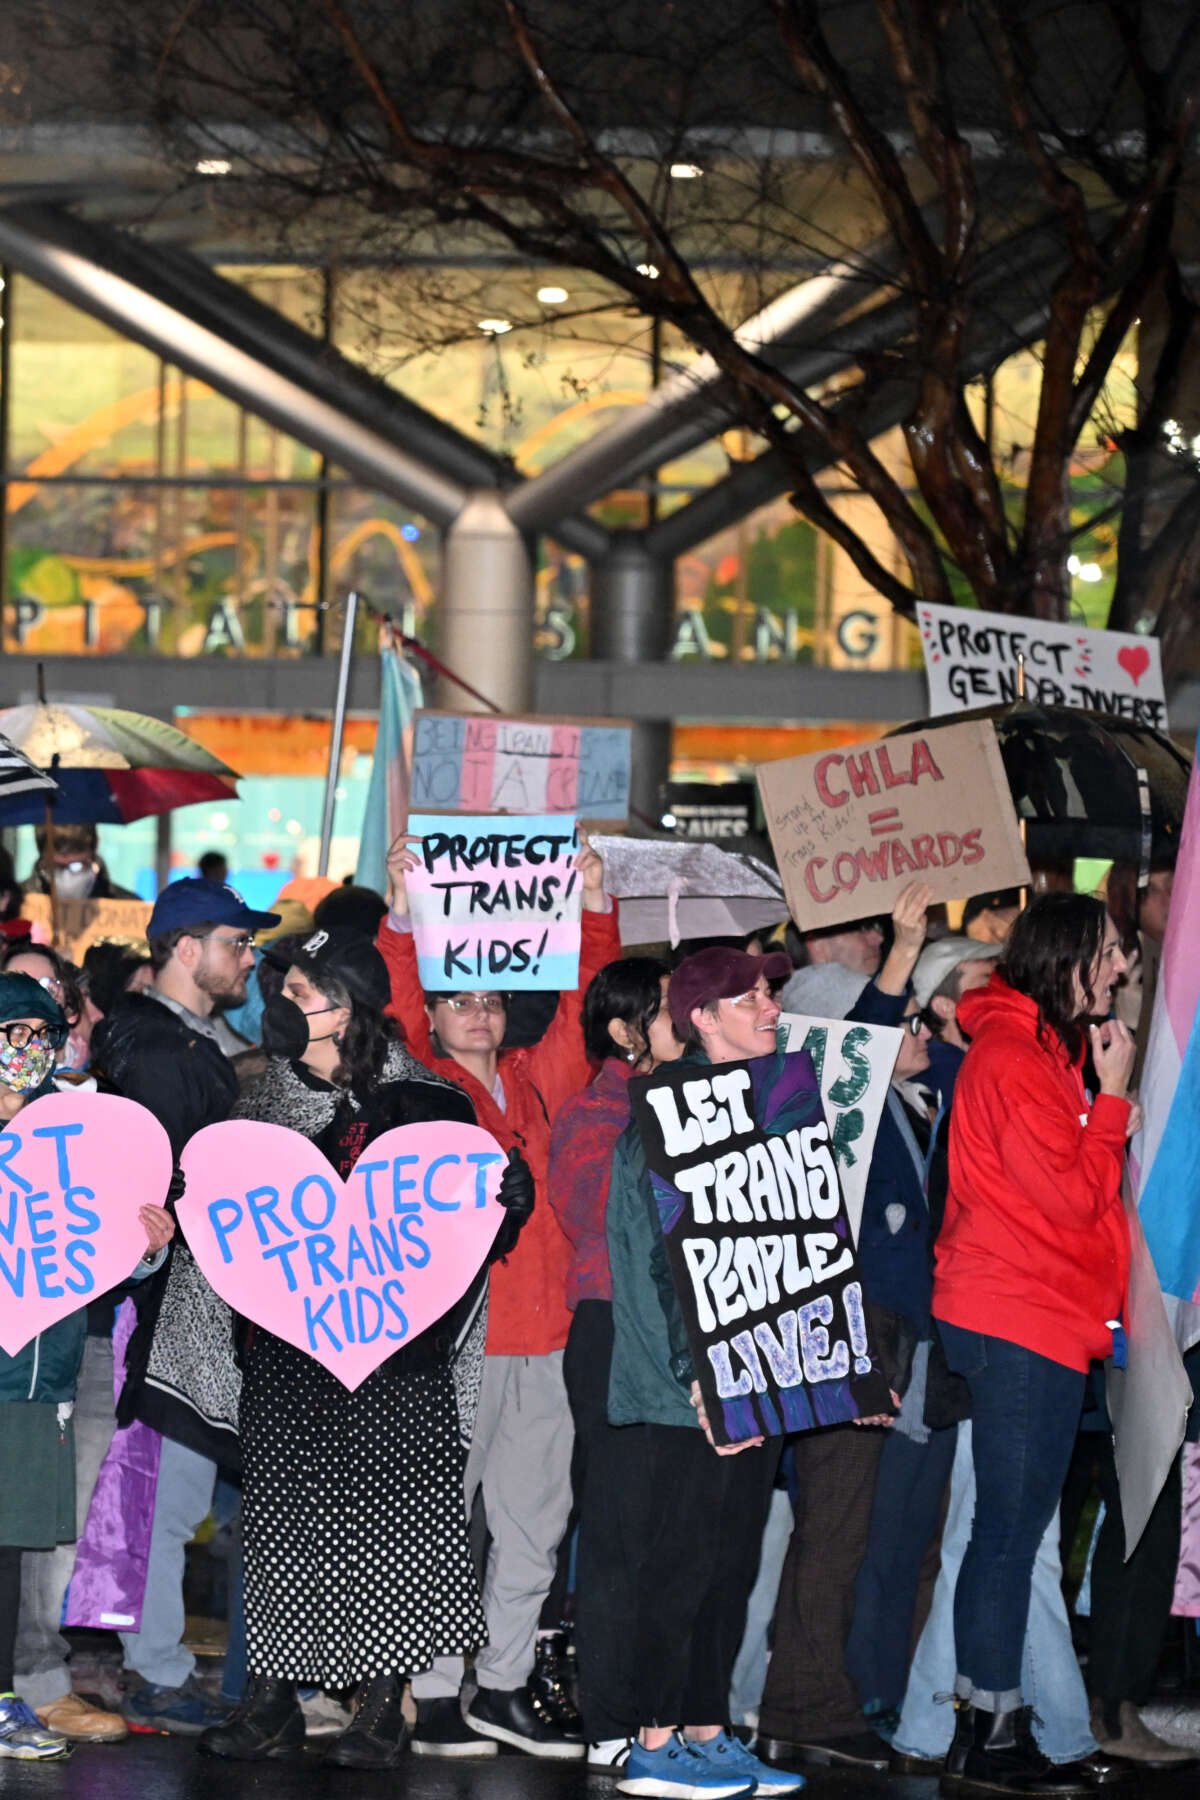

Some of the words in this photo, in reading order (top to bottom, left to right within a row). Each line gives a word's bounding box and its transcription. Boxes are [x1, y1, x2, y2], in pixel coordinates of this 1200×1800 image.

[938, 619, 1072, 674] PROTECT
[814, 738, 945, 808] CHLA
[422, 827, 579, 875] PROTECT!
[804, 828, 986, 904] COWARDS
[430, 869, 578, 922] TRANS!
[443, 927, 550, 980] KIDS!
[645, 1068, 755, 1158] LET
[207, 1152, 504, 1265] PROTECT
[673, 1121, 841, 1224] TRANS
[262, 1213, 432, 1293] TRANS
[681, 1232, 855, 1334] PEOPLE
[303, 1278, 410, 1352] KIDS
[706, 1280, 873, 1399] LIVE!
